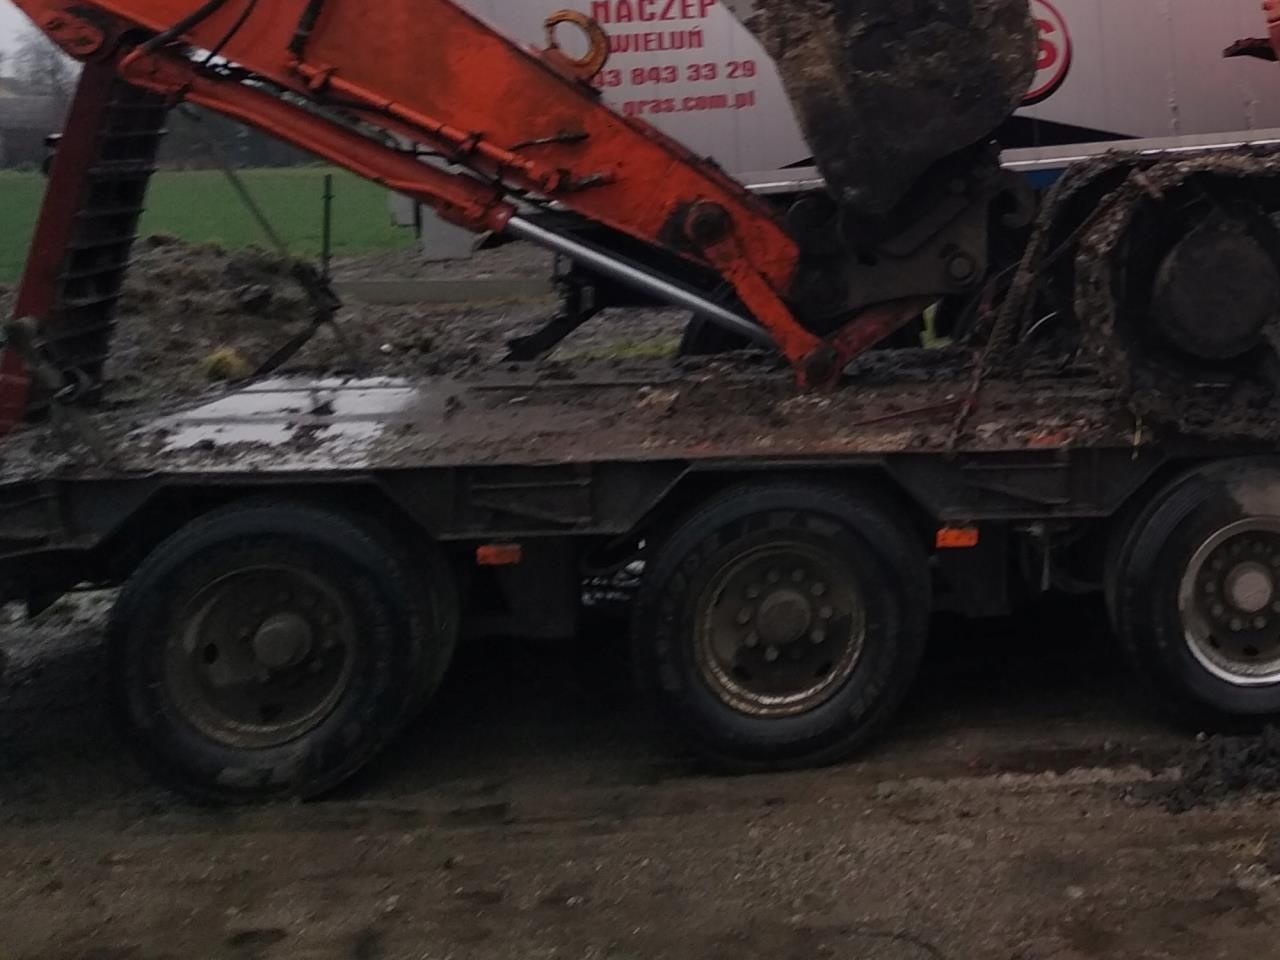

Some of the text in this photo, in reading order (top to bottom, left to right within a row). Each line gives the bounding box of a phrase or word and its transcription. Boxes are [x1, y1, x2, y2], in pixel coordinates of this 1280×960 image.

[631, 65, 678, 86] 843
[687, 62, 718, 81] 33
[726, 60, 757, 79] 29
